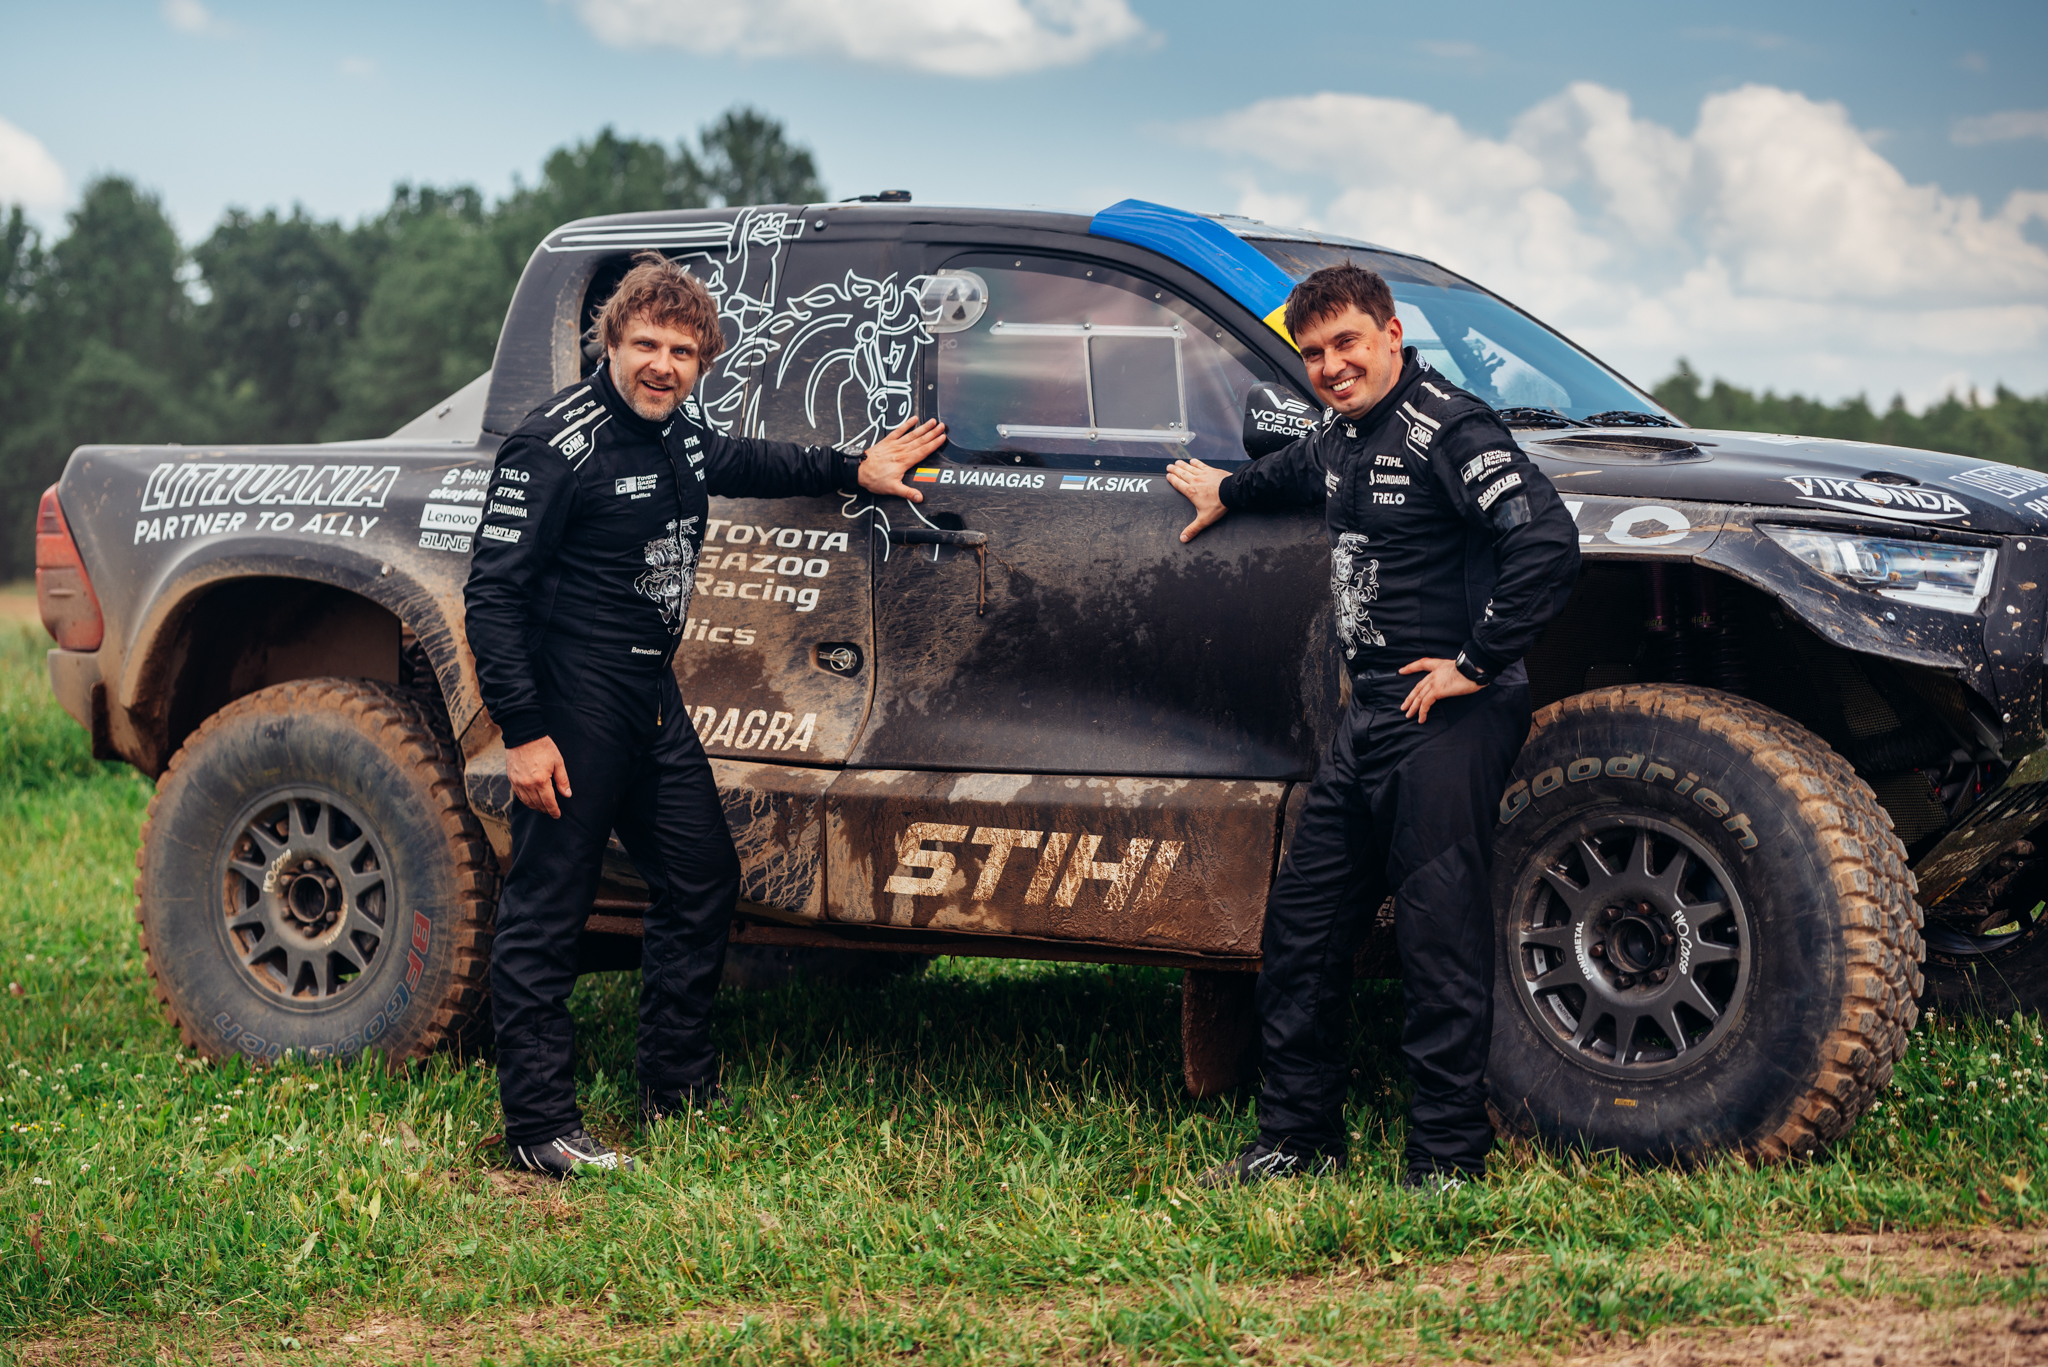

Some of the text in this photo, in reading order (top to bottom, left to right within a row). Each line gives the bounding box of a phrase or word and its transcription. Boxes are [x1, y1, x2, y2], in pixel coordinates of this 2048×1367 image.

[1251, 409, 1319, 432] VOSTOK
[1257, 422, 1308, 439] EUROPE
[1411, 426, 1432, 444] OMP
[562, 434, 585, 456] OMP
[1374, 454, 1404, 468] STIHL
[500, 468, 530, 483] TRELO
[939, 470, 1045, 489] B.VANAGAS
[1086, 476, 1152, 493] K.SIKK
[1376, 473, 1410, 485] SCANDAGRA
[141, 463, 400, 512] LITHUANIA
[428, 487, 487, 503] skaylin
[495, 486, 525, 501] STIHL
[1478, 472, 1521, 507] SANDTLER
[1372, 492, 1405, 505] TRELO
[427, 510, 477, 525] Lenovo
[493, 502, 527, 518] SCANDAGRA
[134, 512, 379, 545] PARTNER TO ALLY
[483, 524, 521, 540] SANDTLER
[706, 519, 848, 552] TOYOTA
[419, 531, 471, 553] JUNG
[699, 546, 830, 578] GAZOO
[695, 572, 820, 612] Racing
[684, 705, 817, 752] DAGRA
[1574, 921, 1593, 981] FONDMETAL
